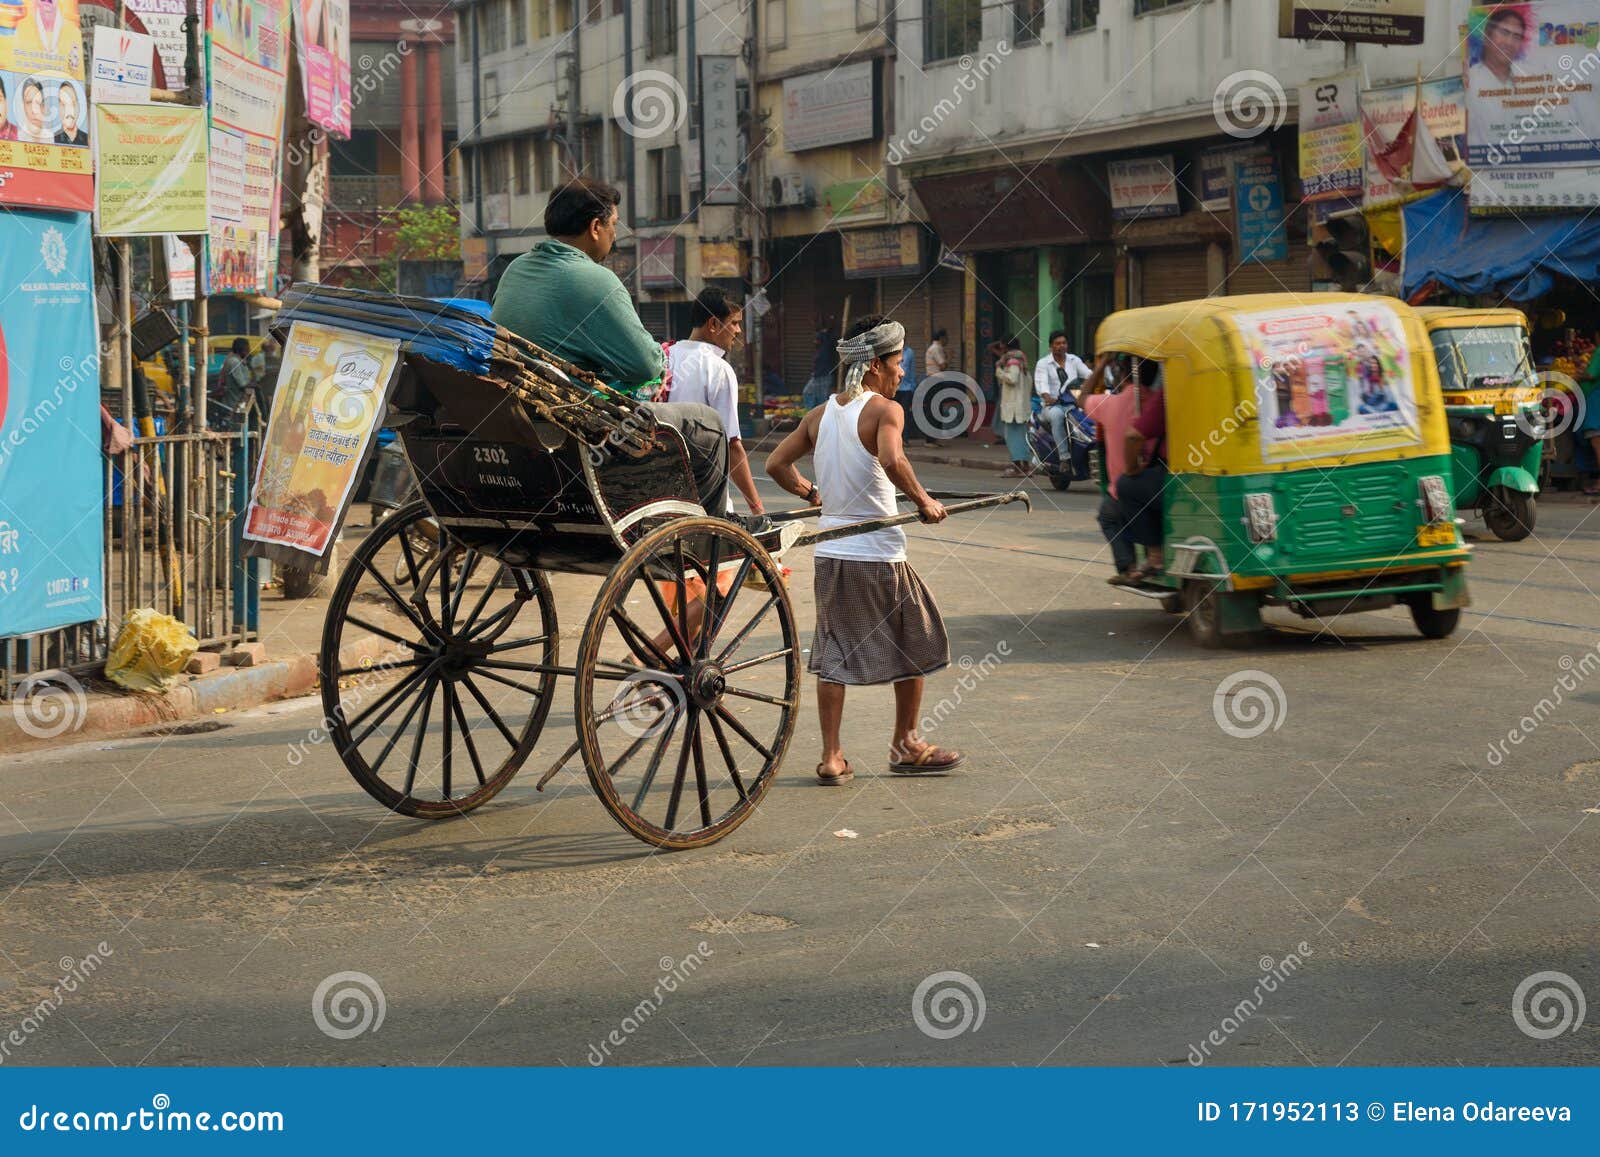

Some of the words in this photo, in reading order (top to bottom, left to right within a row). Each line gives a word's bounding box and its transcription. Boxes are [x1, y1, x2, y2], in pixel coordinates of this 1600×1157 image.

[98, 63, 115, 76] Euro
[712, 63, 729, 166] SPIRAL
[1421, 101, 1458, 120] Garden
[474, 446, 509, 465] 2302
